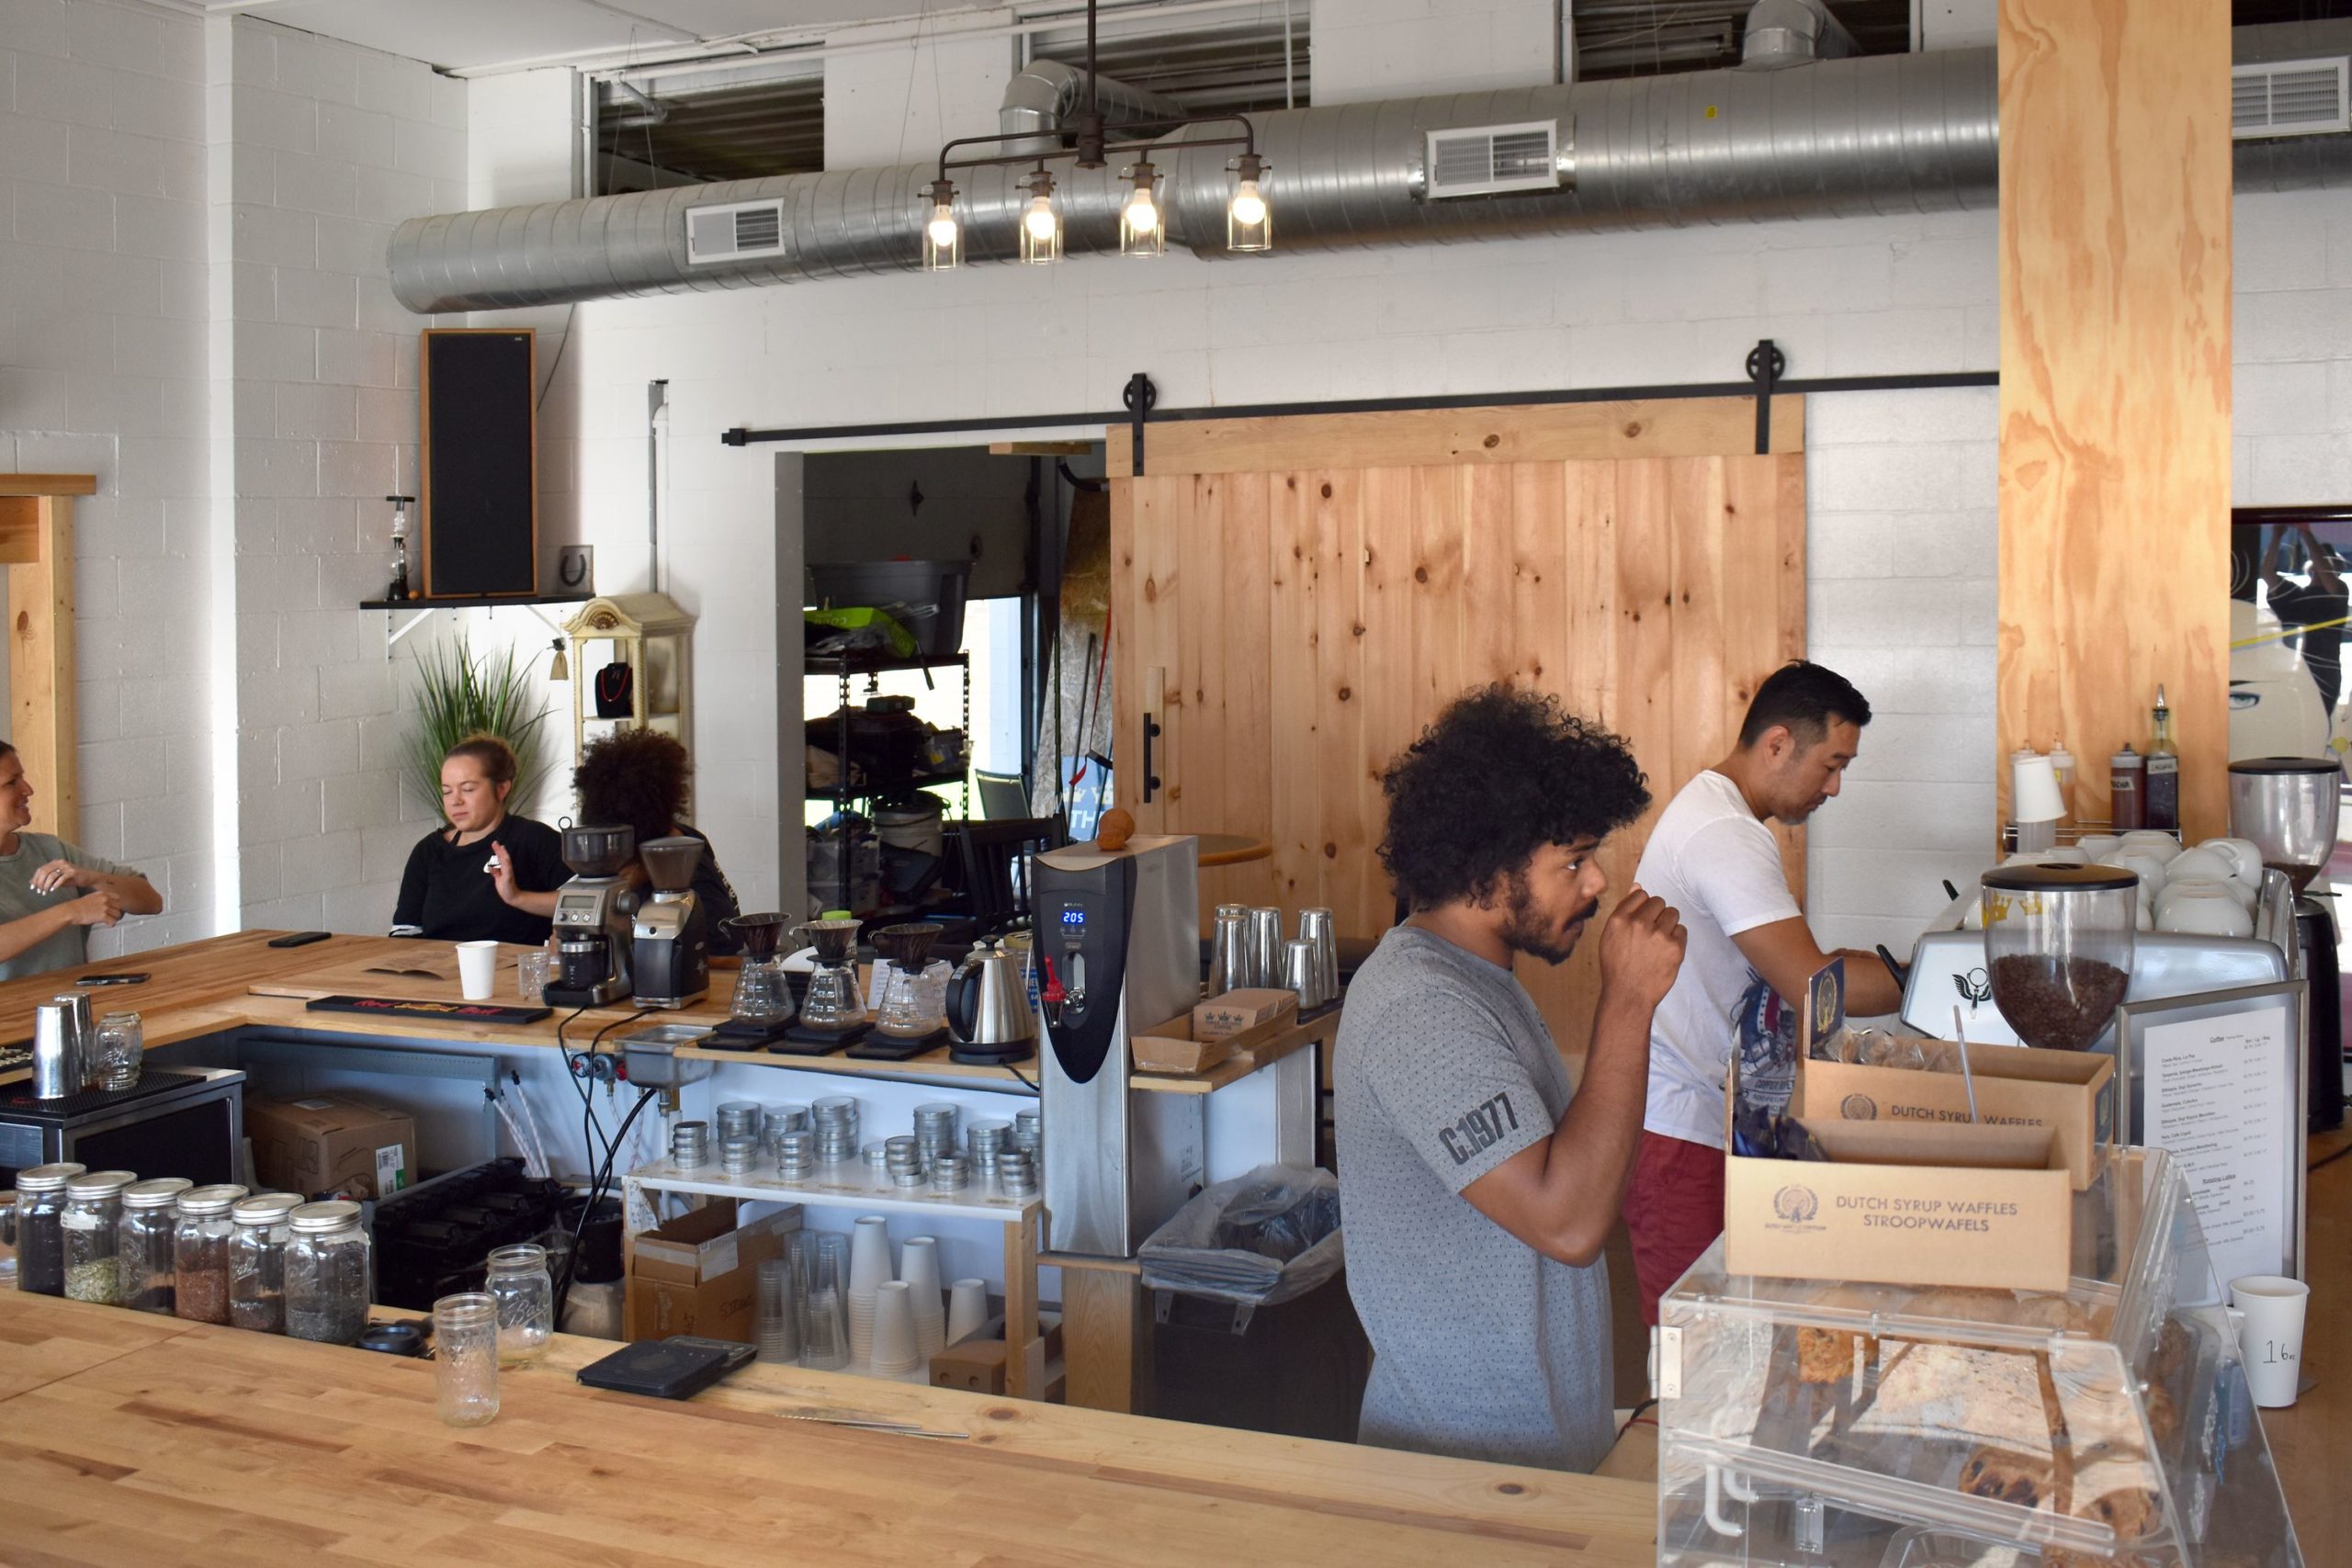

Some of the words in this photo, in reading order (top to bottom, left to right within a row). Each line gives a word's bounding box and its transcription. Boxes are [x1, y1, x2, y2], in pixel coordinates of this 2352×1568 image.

[1063, 912, 1083, 923] 205
[1892, 1105, 1934, 1119] DUTCH
[1939, 1110, 1973, 1123] SYRU
[1439, 1091, 1519, 1166] C.1977
[1837, 1197, 1887, 1210] DUTCH
[1894, 1199, 1941, 1213] SYRUP
[1948, 1201, 2018, 1215] WAFFLES
[1863, 1213, 1989, 1232] STROOPWAFELS
